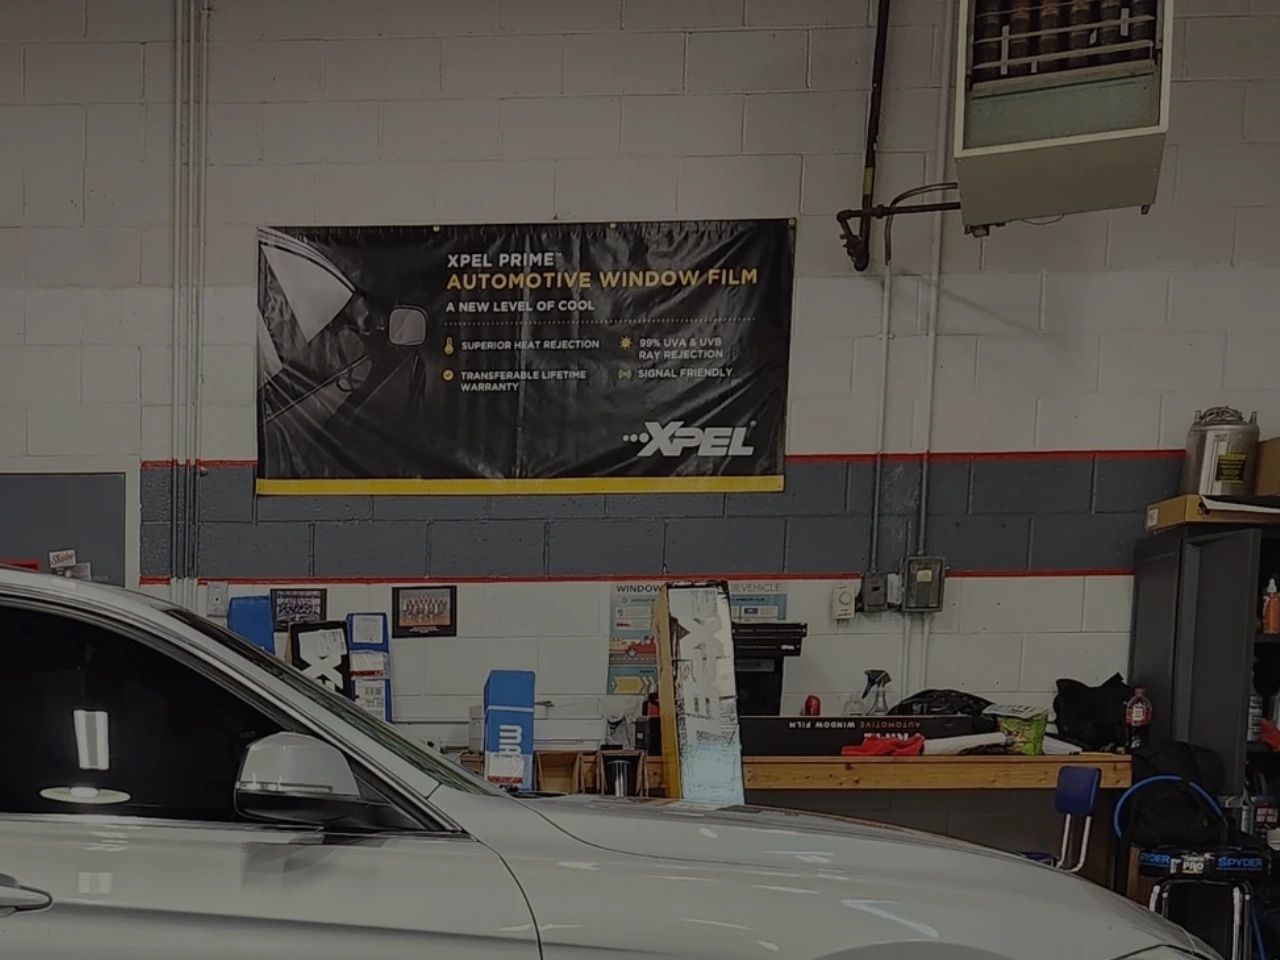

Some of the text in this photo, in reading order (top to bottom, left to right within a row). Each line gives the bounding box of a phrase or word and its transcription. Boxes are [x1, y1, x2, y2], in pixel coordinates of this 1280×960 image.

[447, 253, 493, 268] XPEL
[446, 268, 758, 290] AUTOMOTIVE WINDOW FILM
[445, 299, 595, 313] A NEW LEVEL OF COOL
[461, 339, 600, 350] SUPERIOR HEAT REJECTION
[639, 338, 661, 347] 99%
[663, 338, 687, 347] UVA
[700, 337, 722, 347] UVB
[638, 349, 723, 360] RAY REJECTION
[460, 370, 587, 380] TRANSFERABLE LIFETIME
[638, 367, 734, 378] SIGNAL FRIENDLY
[460, 382, 520, 392] WARRANTY
[637, 420, 755, 457] XPEL
